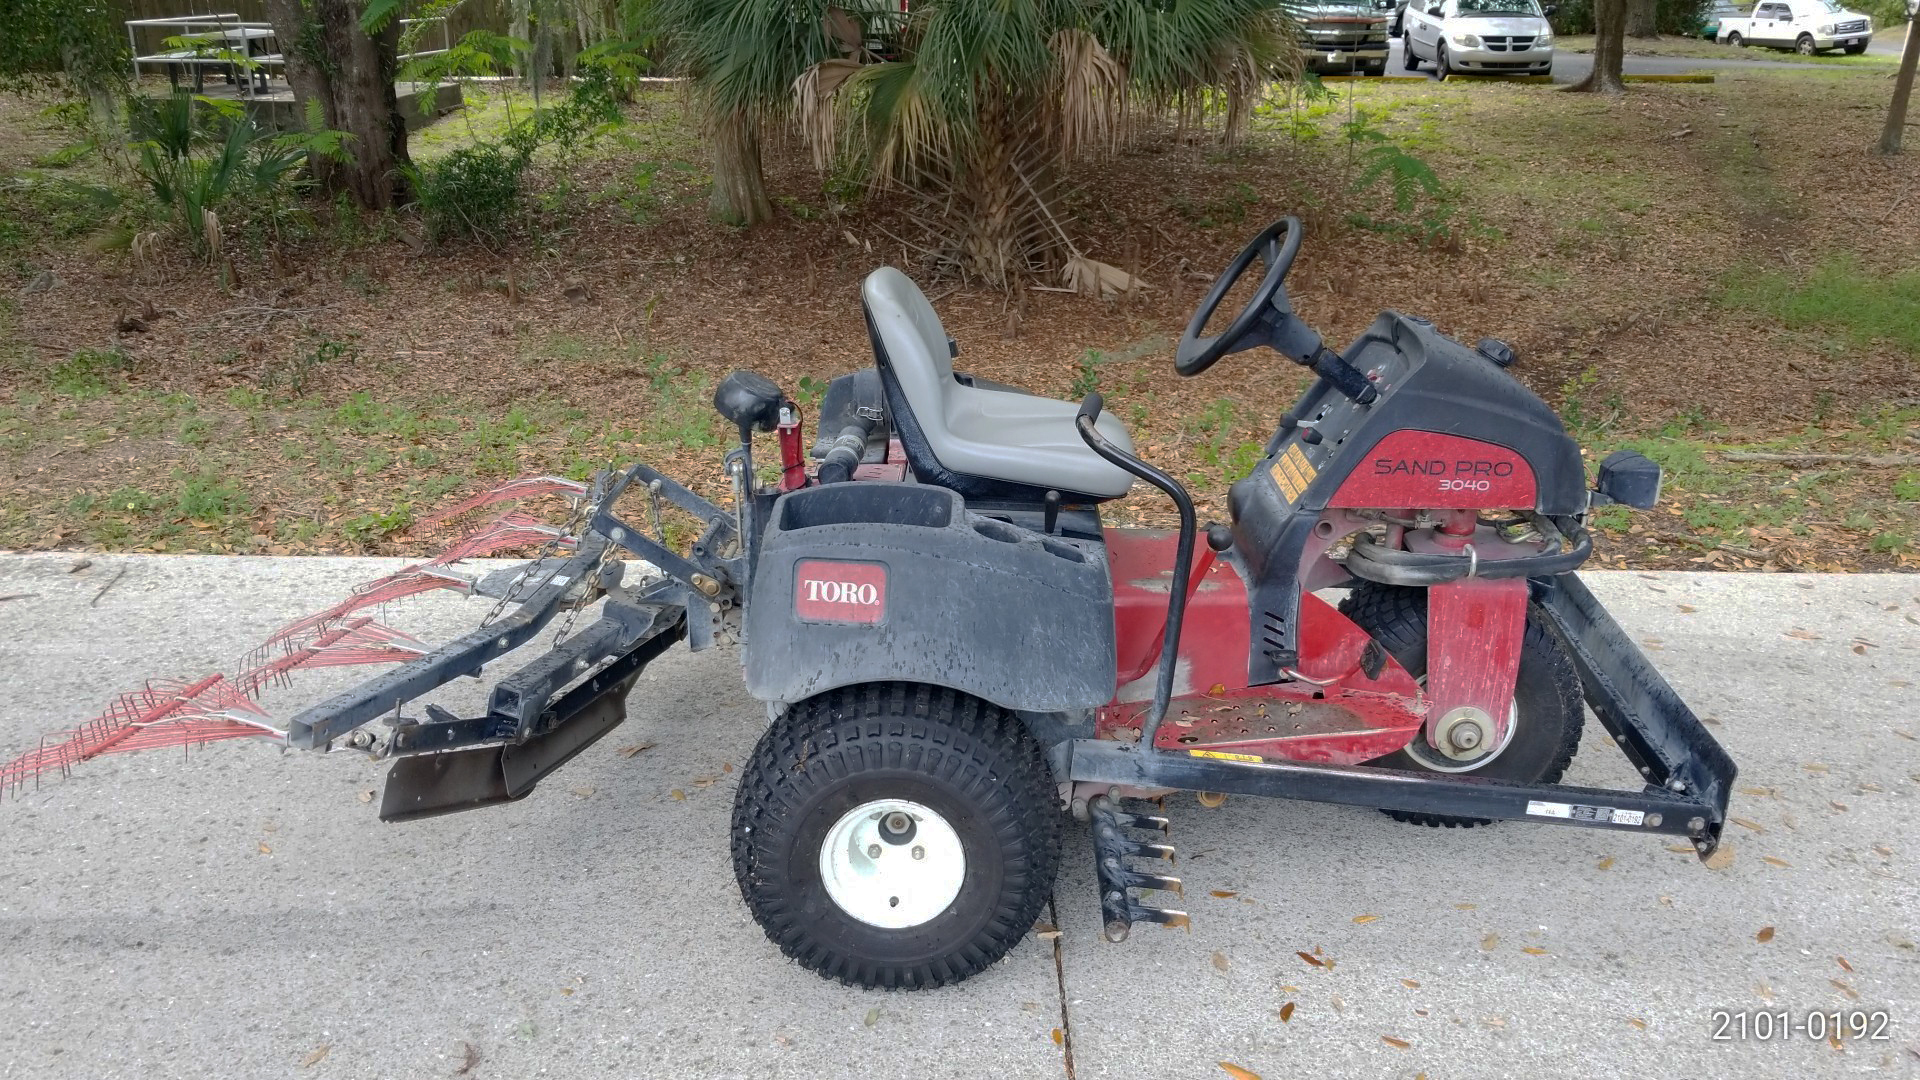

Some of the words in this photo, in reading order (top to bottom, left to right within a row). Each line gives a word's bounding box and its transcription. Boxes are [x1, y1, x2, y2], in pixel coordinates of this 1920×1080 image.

[1374, 459, 1446, 476] SAND
[1454, 460, 1513, 477] PRO
[1438, 479, 1490, 491] 3040
[804, 579, 878, 605] TORO
